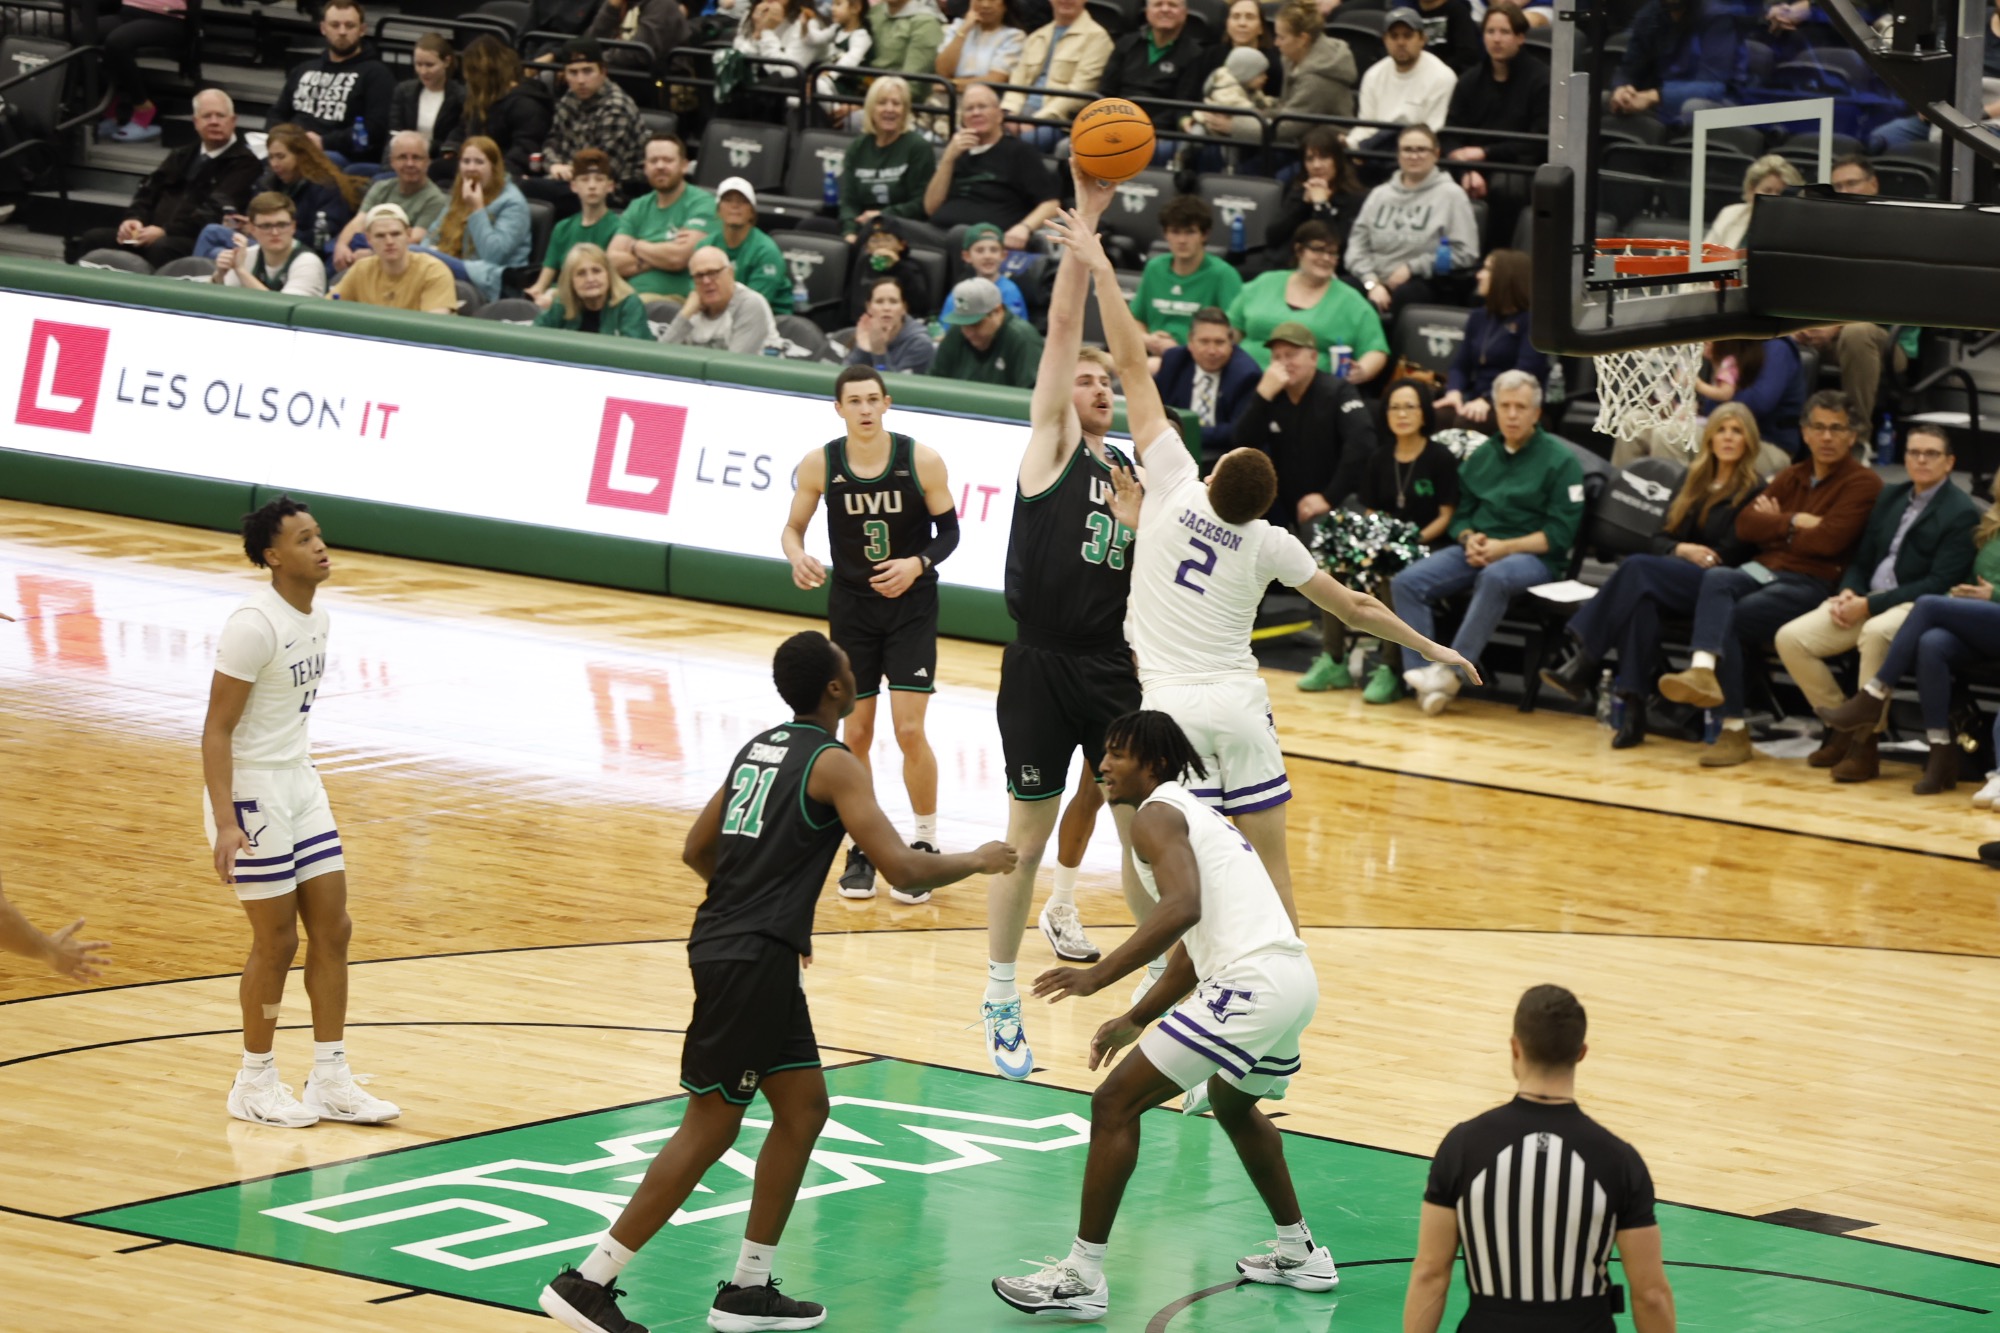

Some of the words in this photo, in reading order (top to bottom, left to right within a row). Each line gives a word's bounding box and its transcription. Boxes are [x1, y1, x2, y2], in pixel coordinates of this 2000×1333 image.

[116, 367, 188, 410] LES
[203, 379, 346, 430] OLSON
[359, 400, 400, 439] IT
[695, 446, 772, 491] LES
[956, 482, 1001, 522] IT
[843, 490, 903, 515] UVU
[862, 519, 891, 562] 3
[1080, 510, 1137, 571] 35
[1179, 508, 1243, 552] JACKSON
[1174, 536, 1218, 596] 2
[721, 763, 780, 838] 21
